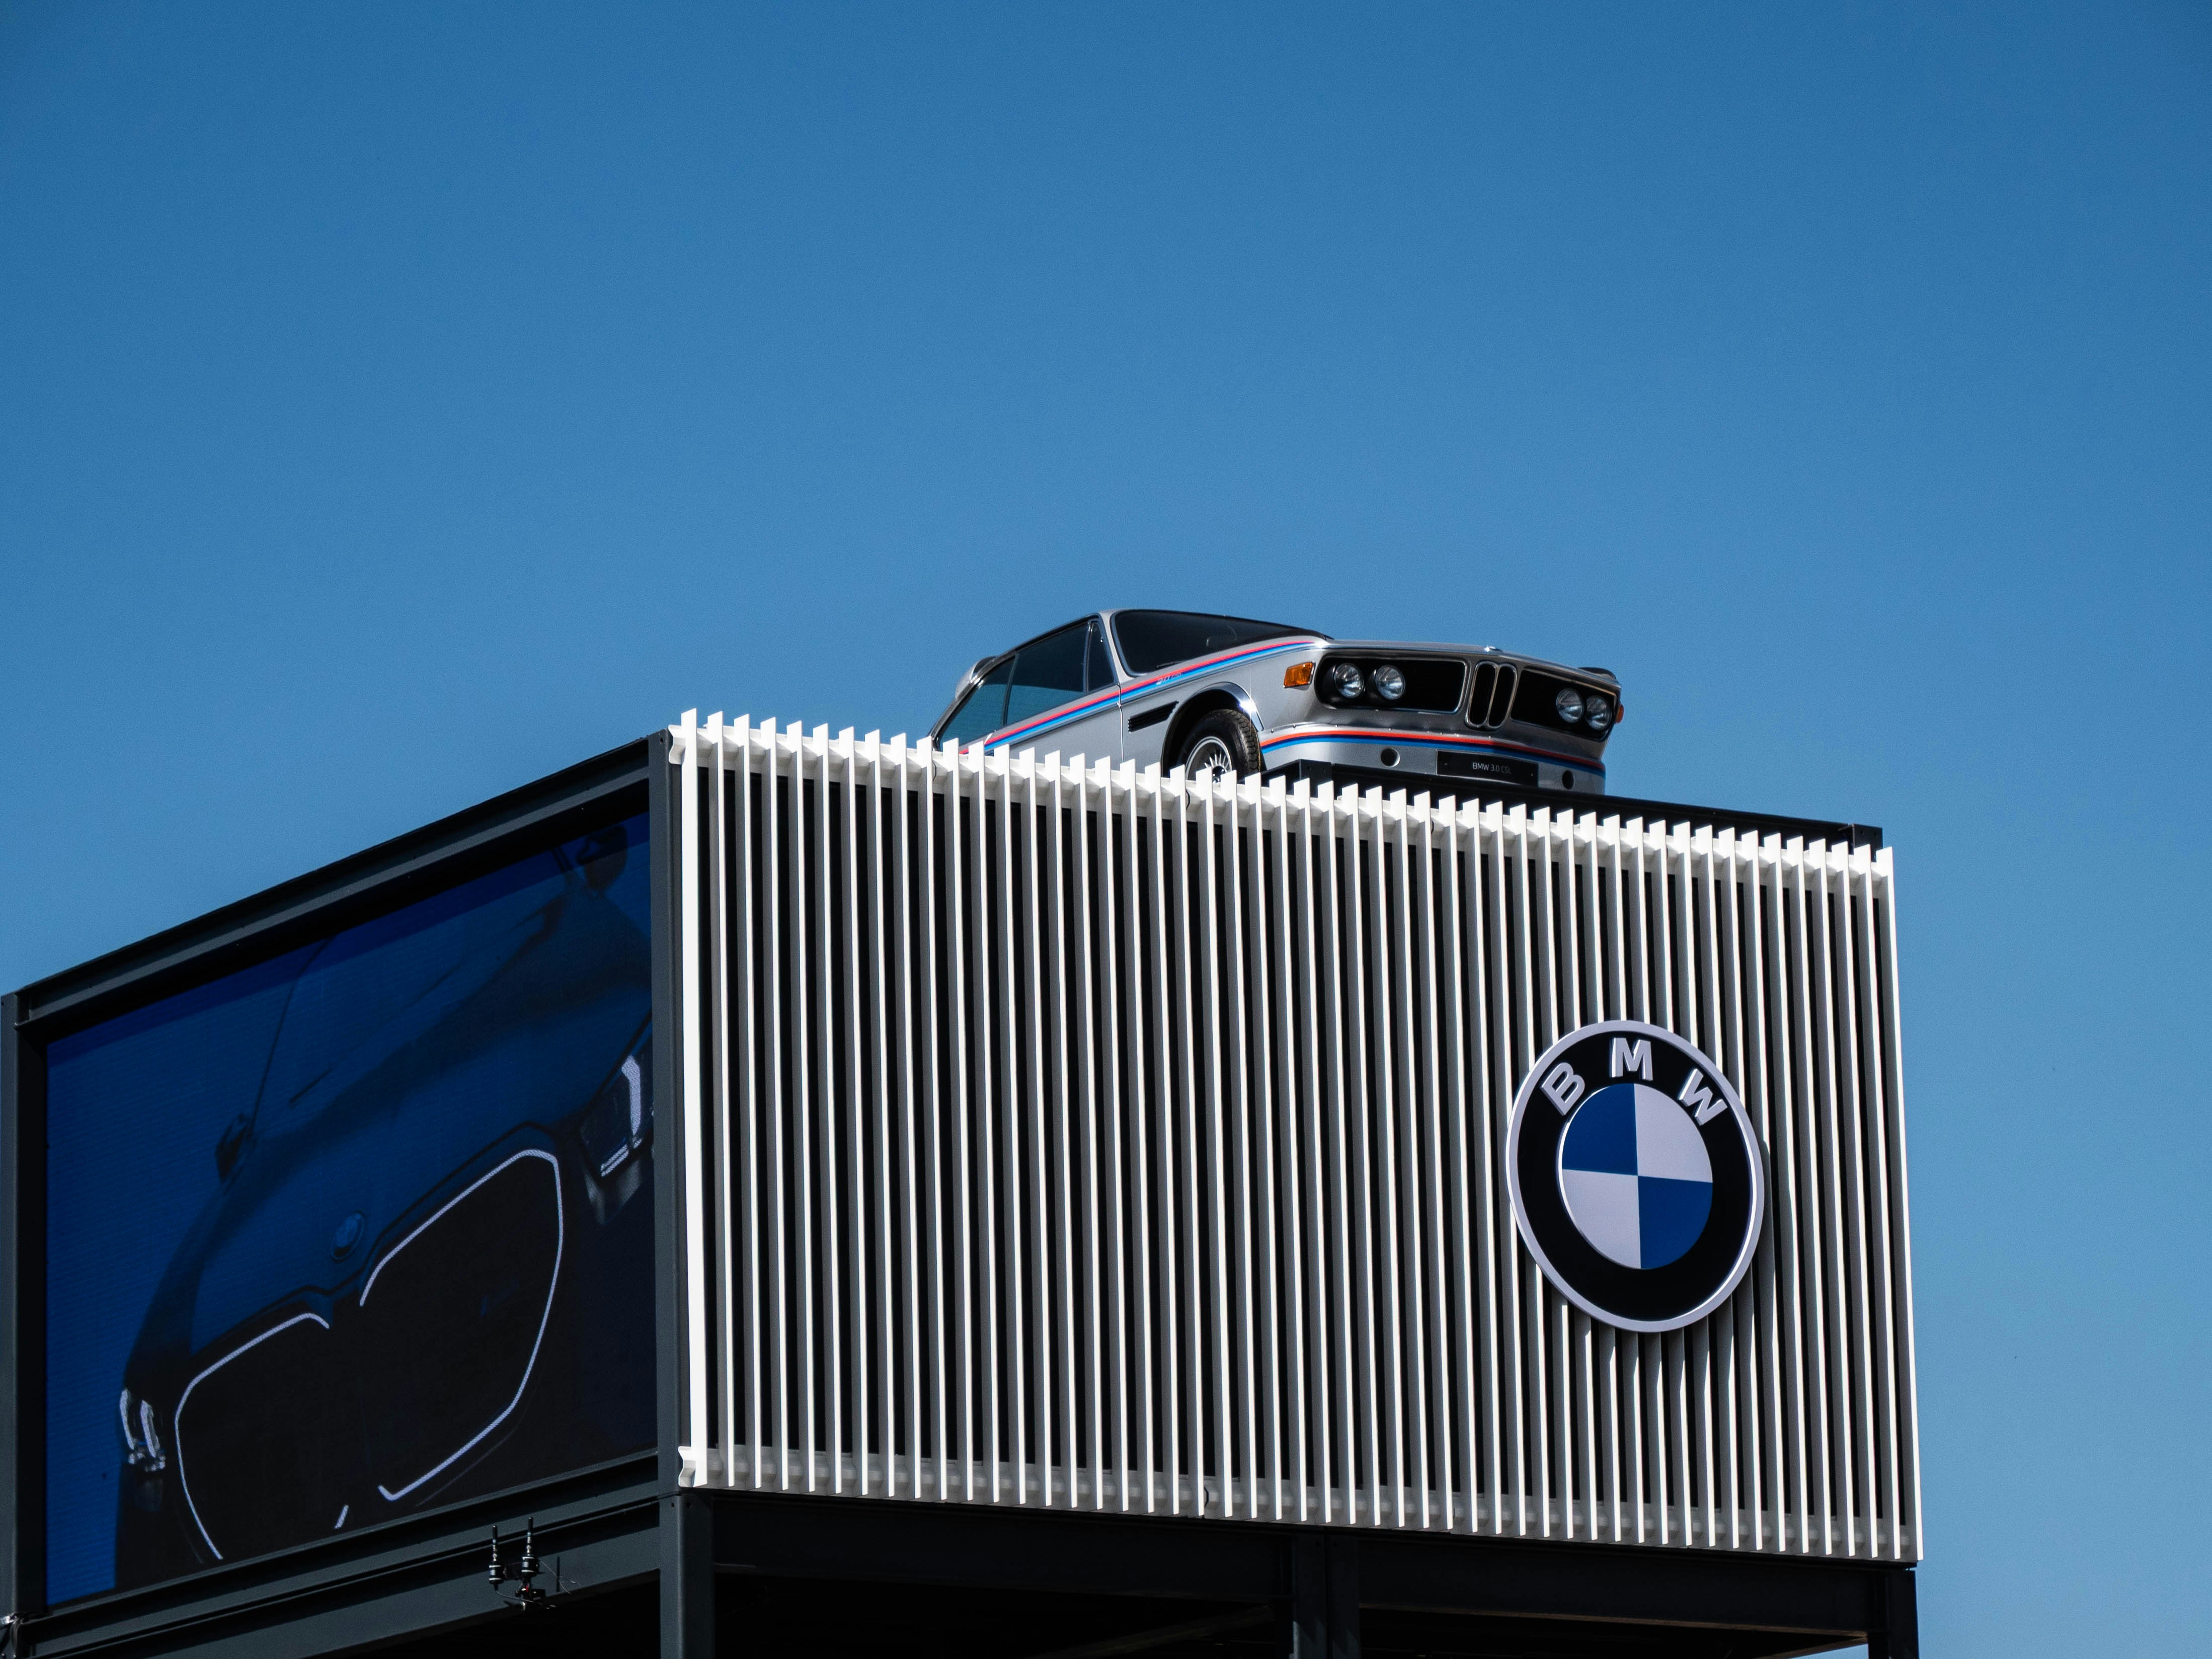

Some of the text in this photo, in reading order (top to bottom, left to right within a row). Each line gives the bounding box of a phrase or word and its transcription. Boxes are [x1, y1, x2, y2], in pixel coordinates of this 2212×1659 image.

[1472, 762, 1489, 771] BMW
[1490, 764, 1500, 772] 3.0
[1541, 1038, 1728, 1126] BMW
